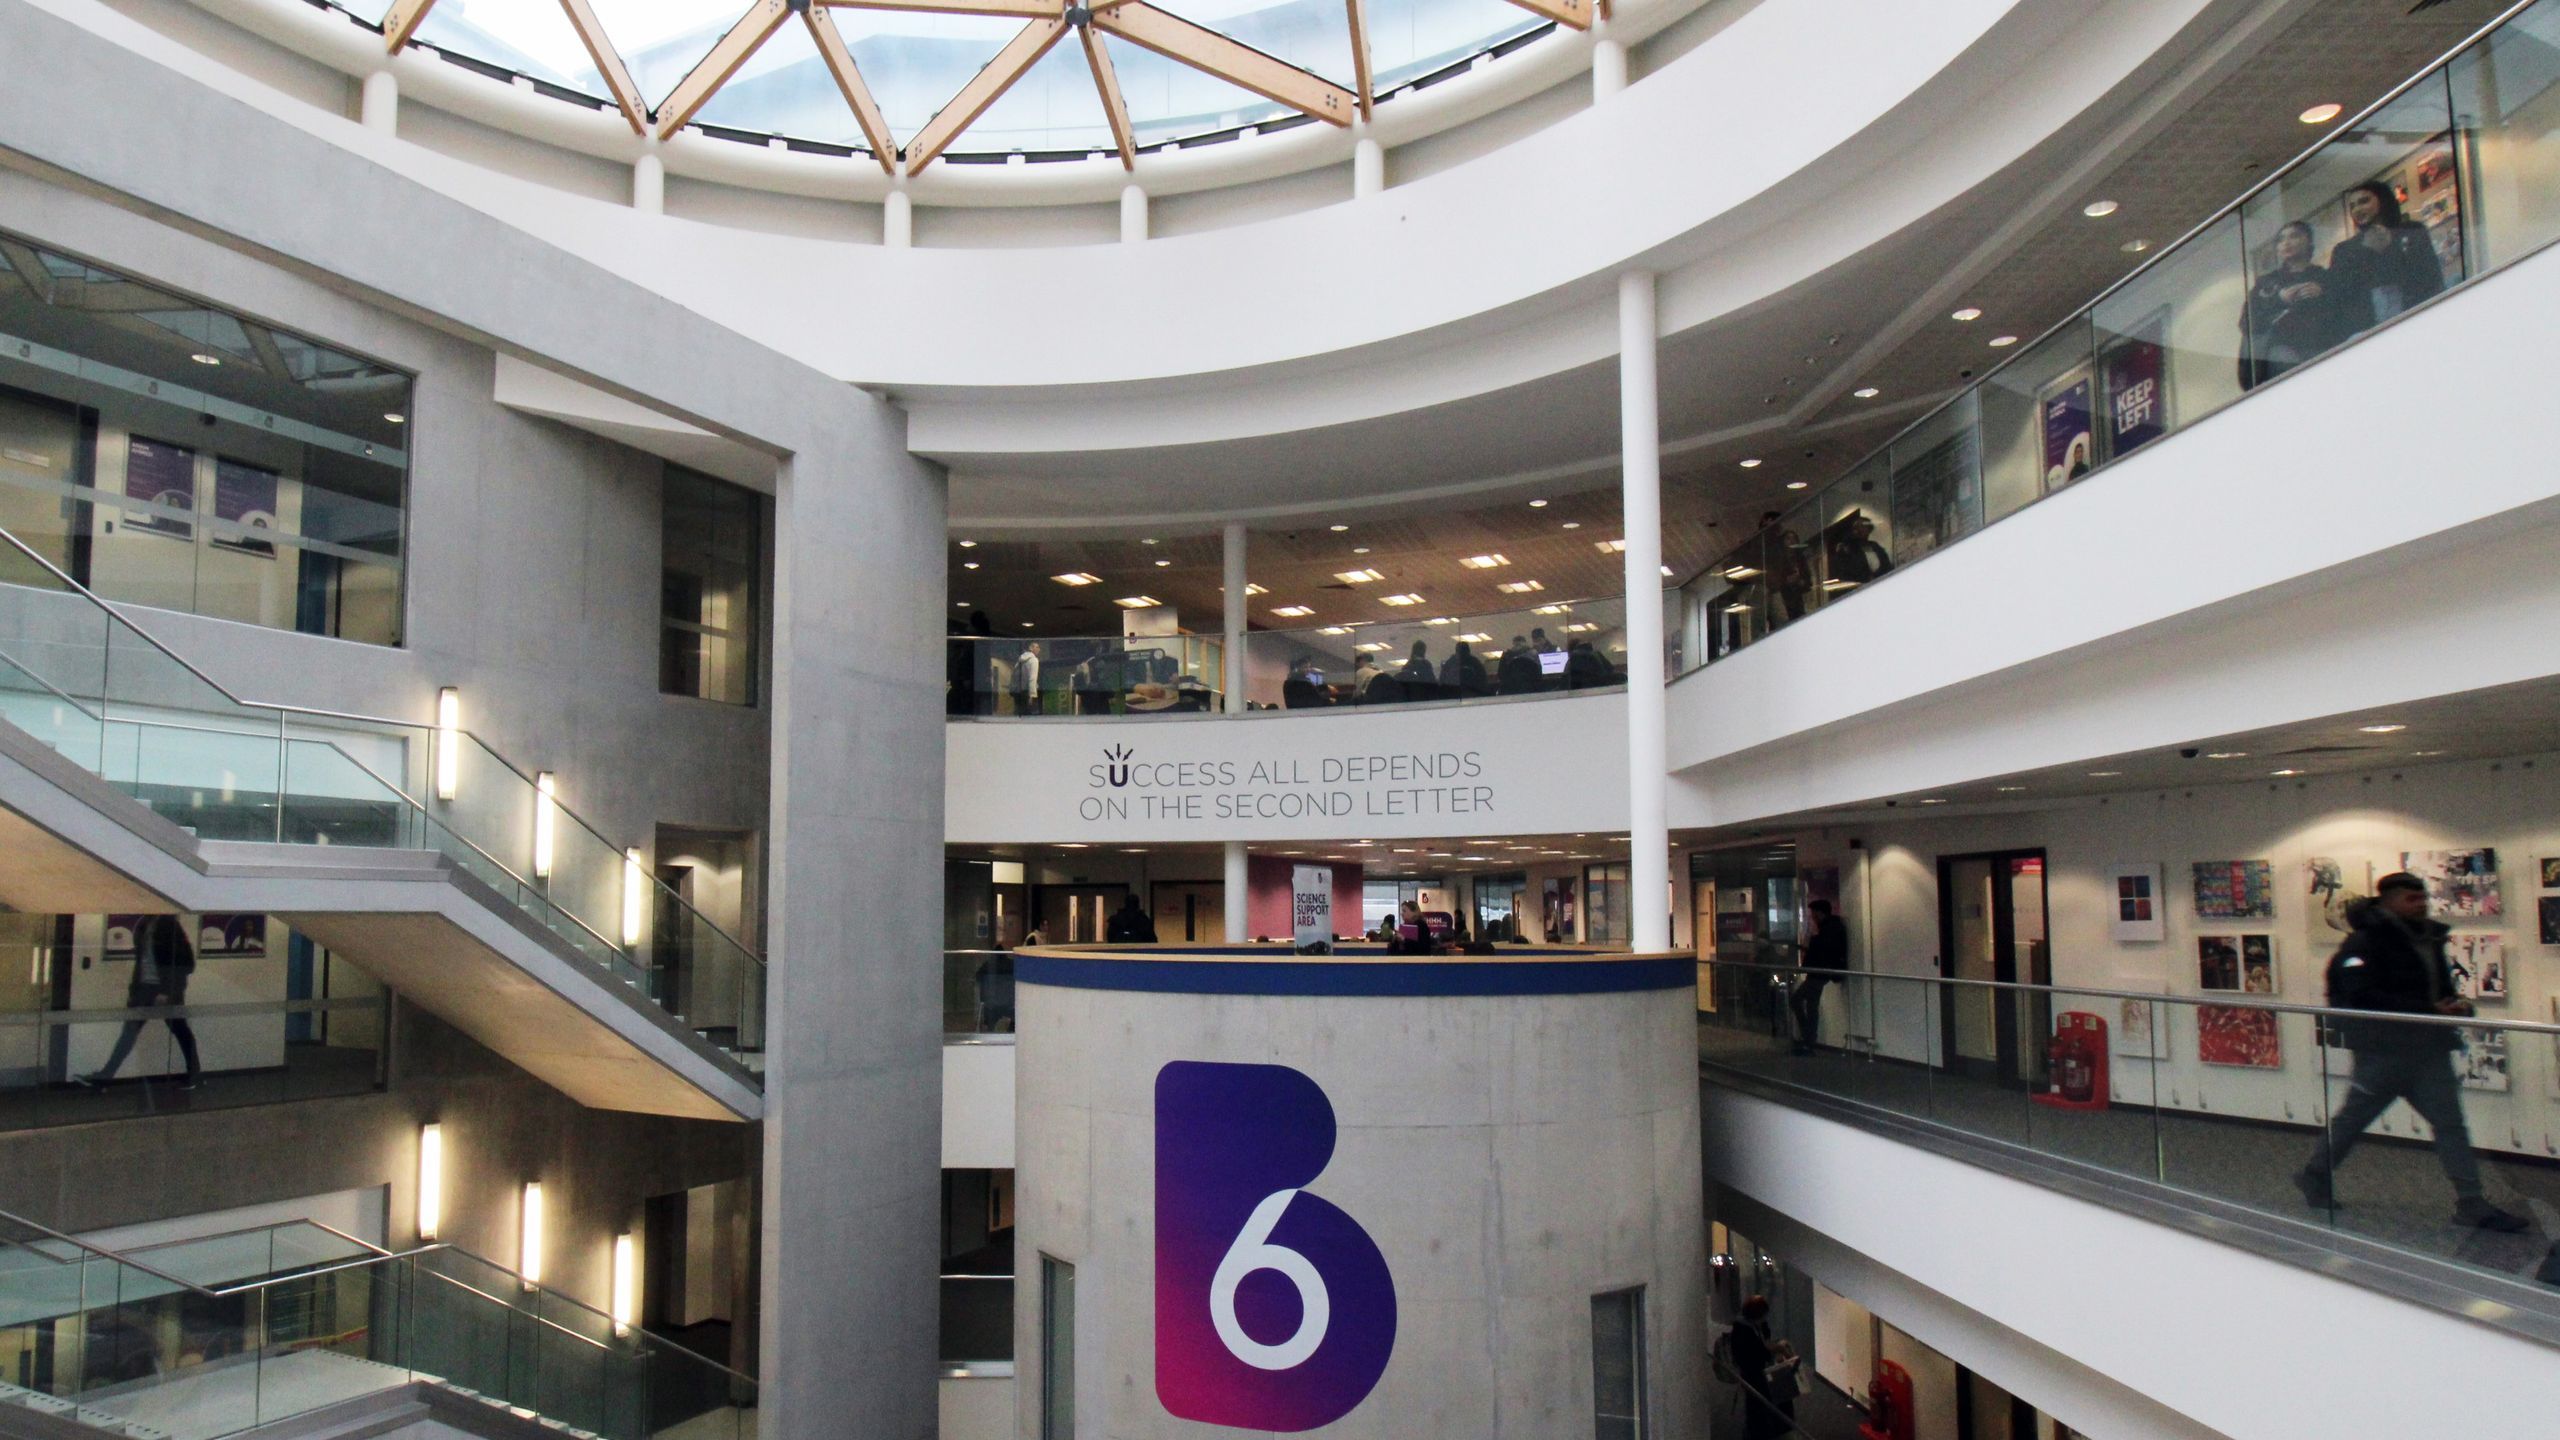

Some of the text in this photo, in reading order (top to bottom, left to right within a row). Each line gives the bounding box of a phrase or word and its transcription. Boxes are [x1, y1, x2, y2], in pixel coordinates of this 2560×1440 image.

[2116, 378, 2153, 415] KEEP
[2118, 399, 2153, 434] LEFT
[1089, 752, 1481, 788] SUCCESS ALL DEPENDS
[1080, 787, 1494, 820] ON THE SECOND LETTER
[1297, 893, 1326, 904] SCIENCE
[1297, 905, 1329, 915] SUPPORT
[1297, 916, 1316, 927] AREA
